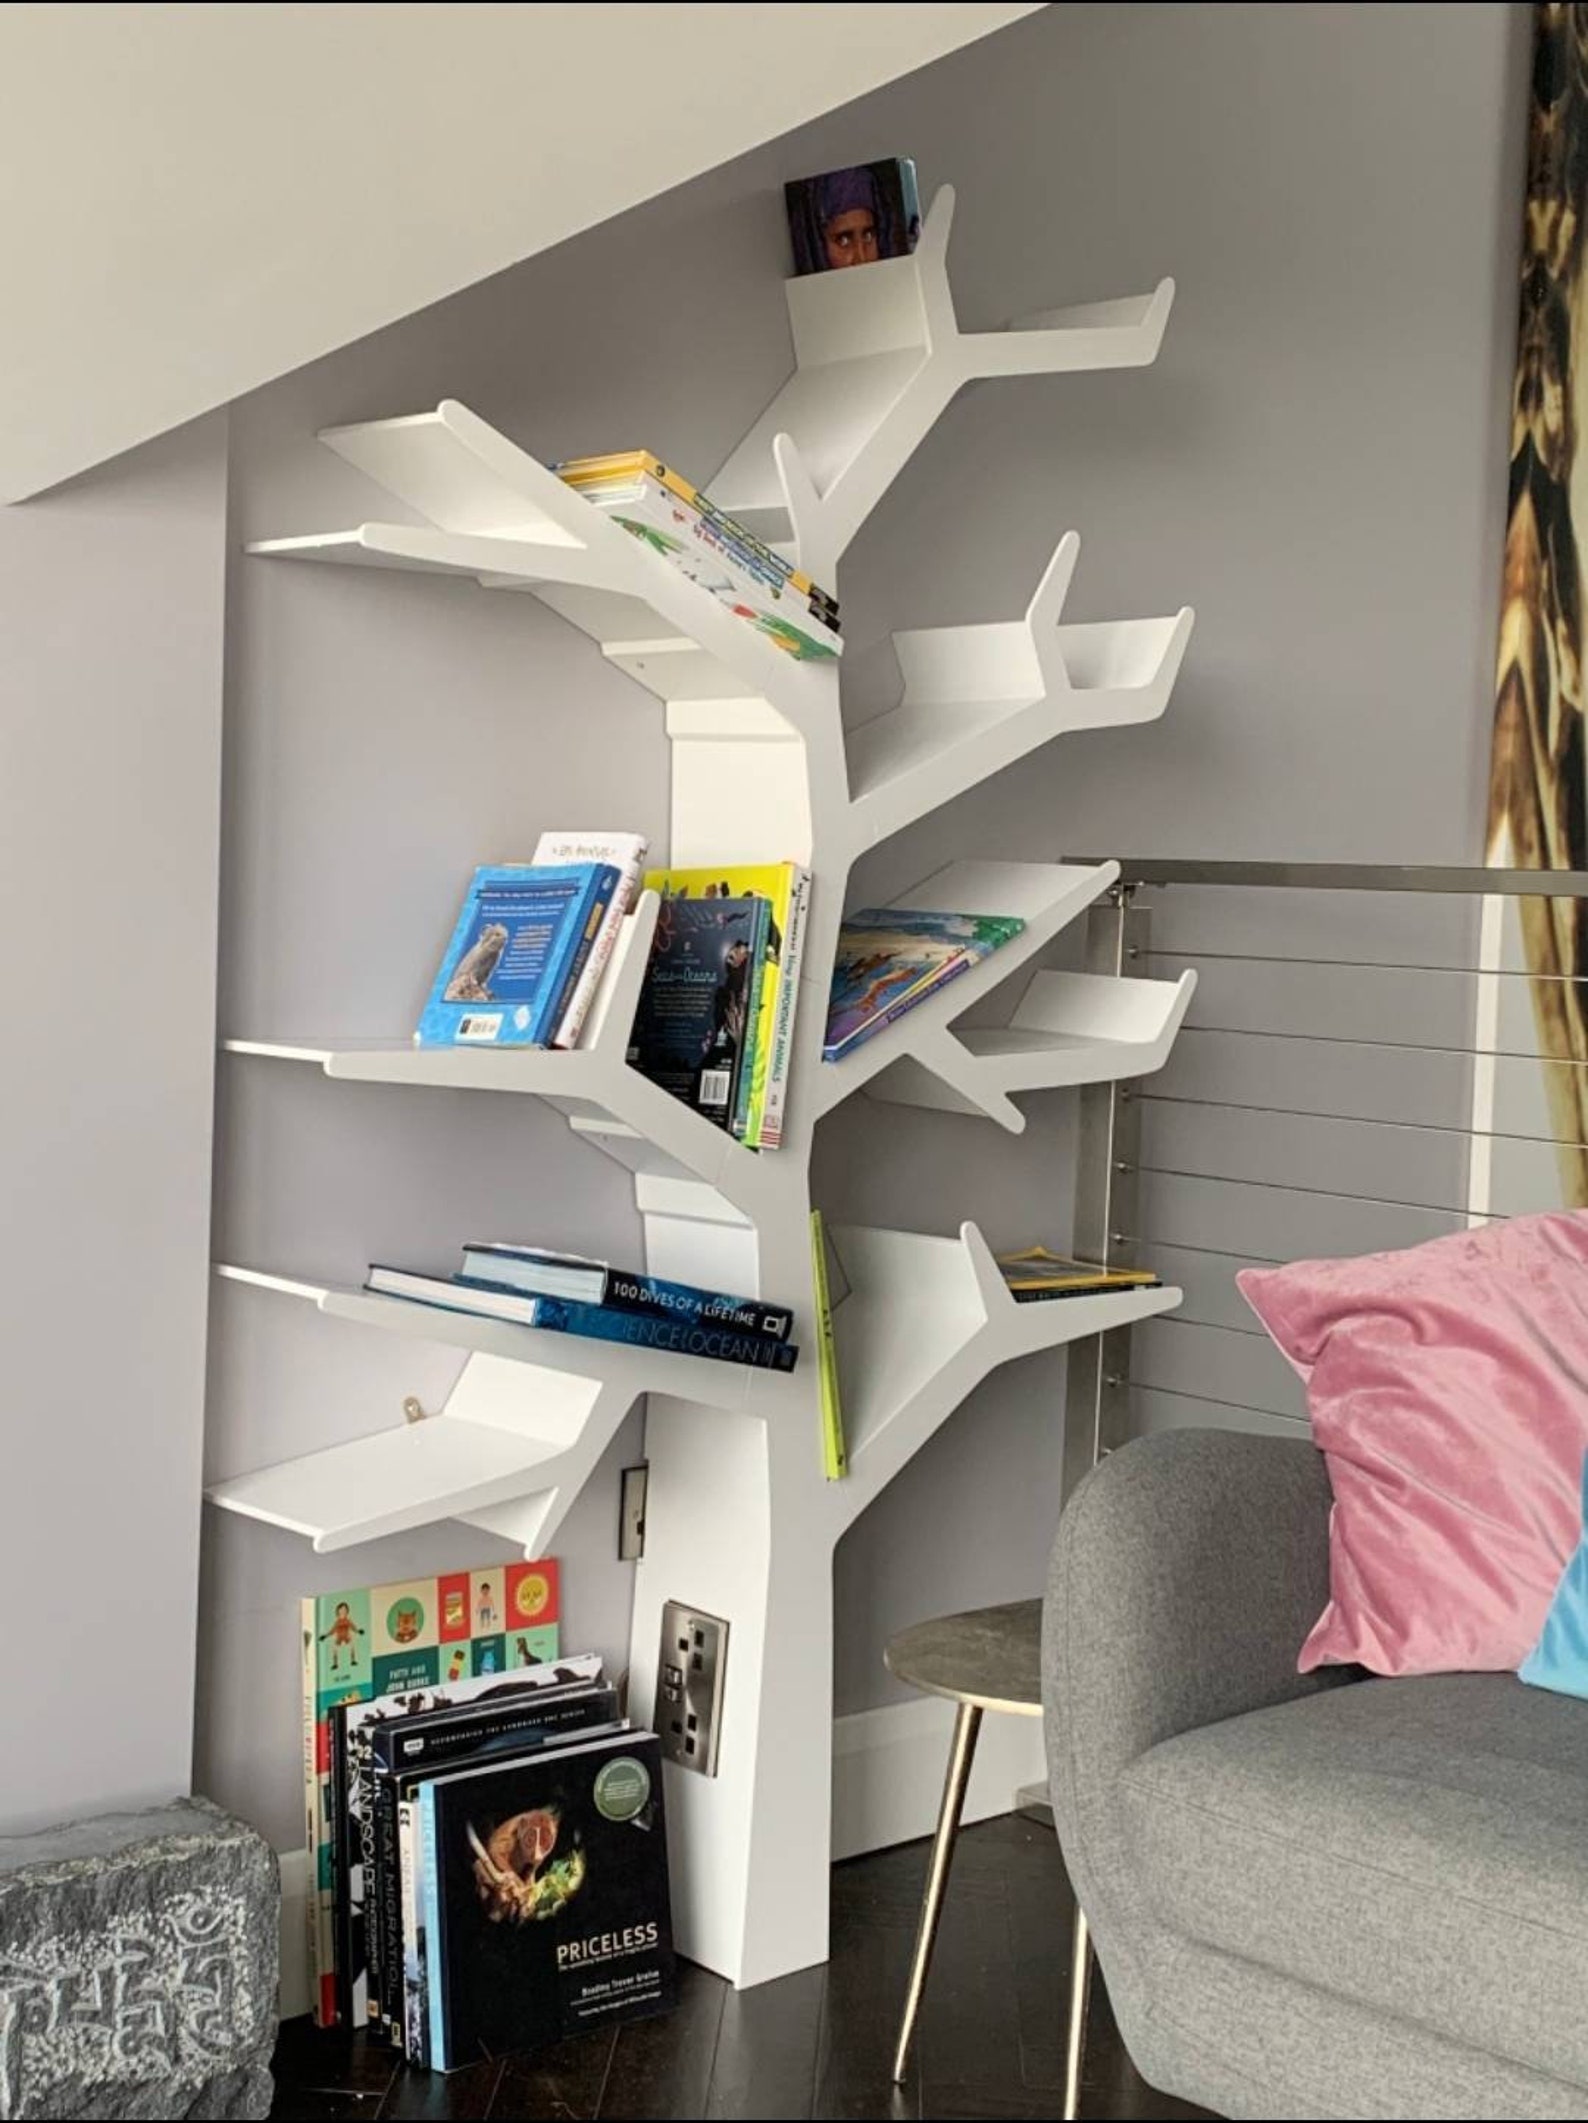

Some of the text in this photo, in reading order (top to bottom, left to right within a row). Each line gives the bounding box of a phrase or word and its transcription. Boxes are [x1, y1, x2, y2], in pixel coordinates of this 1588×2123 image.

[613, 1281, 756, 1326] 100 DIVES OF A LIFETIME
[687, 1331, 760, 1364] OCEAN
[358, 1766, 377, 1895] LANDSCAPE
[557, 1921, 658, 1964] PRICELESS
